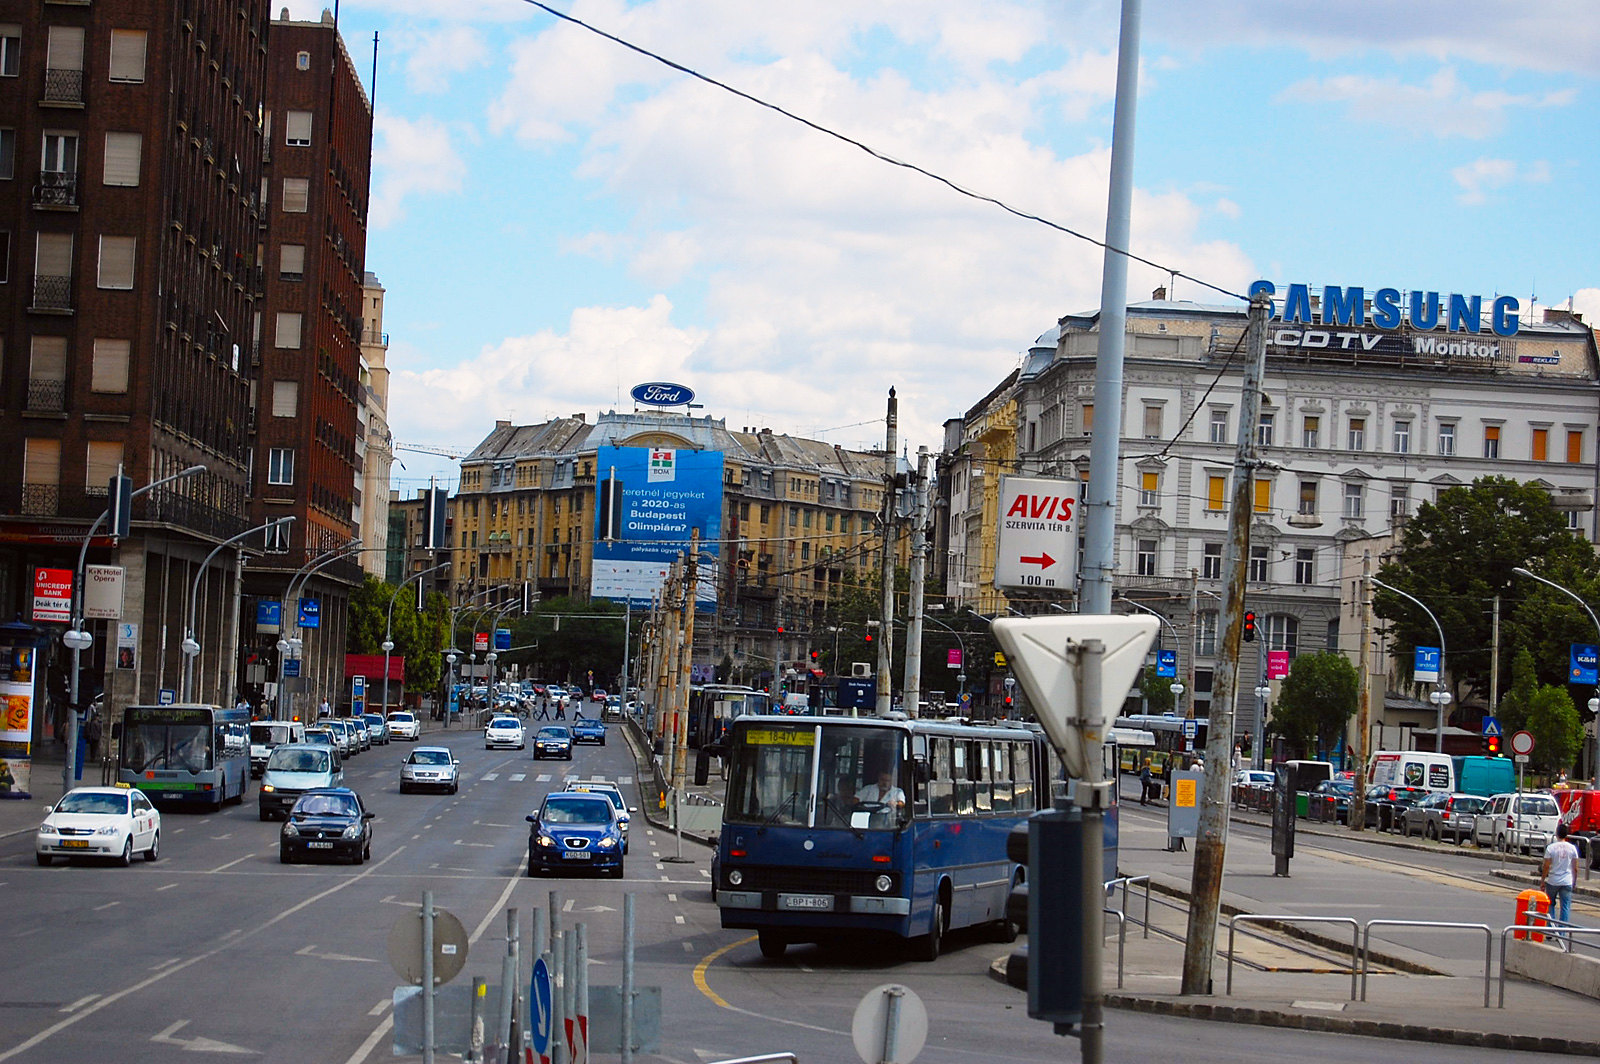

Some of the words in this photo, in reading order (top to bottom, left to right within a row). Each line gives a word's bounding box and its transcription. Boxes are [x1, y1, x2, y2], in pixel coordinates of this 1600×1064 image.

[1246, 280, 1519, 337] SAMSUNG
[1266, 329, 1330, 348] CD
[1336, 331, 1383, 350] TV
[1415, 337, 1499, 357] Monitor
[643, 385, 681, 402] Ford
[622, 489, 660, 497] zeretnél
[663, 490, 705, 499] jegyeket
[641, 500, 686, 509] 2020-as
[1006, 494, 1076, 521] AVIS
[630, 510, 686, 520] Budapesti
[628, 522, 687, 532] Olimpiára?
[1006, 521, 1046, 531] SZERVITA
[1049, 522, 1063, 532] TÉR
[36, 582, 72, 590] UNICREDIT
[1020, 575, 1041, 586] 100
[1045, 578, 1055, 586] m
[52, 600, 62, 608] tér
